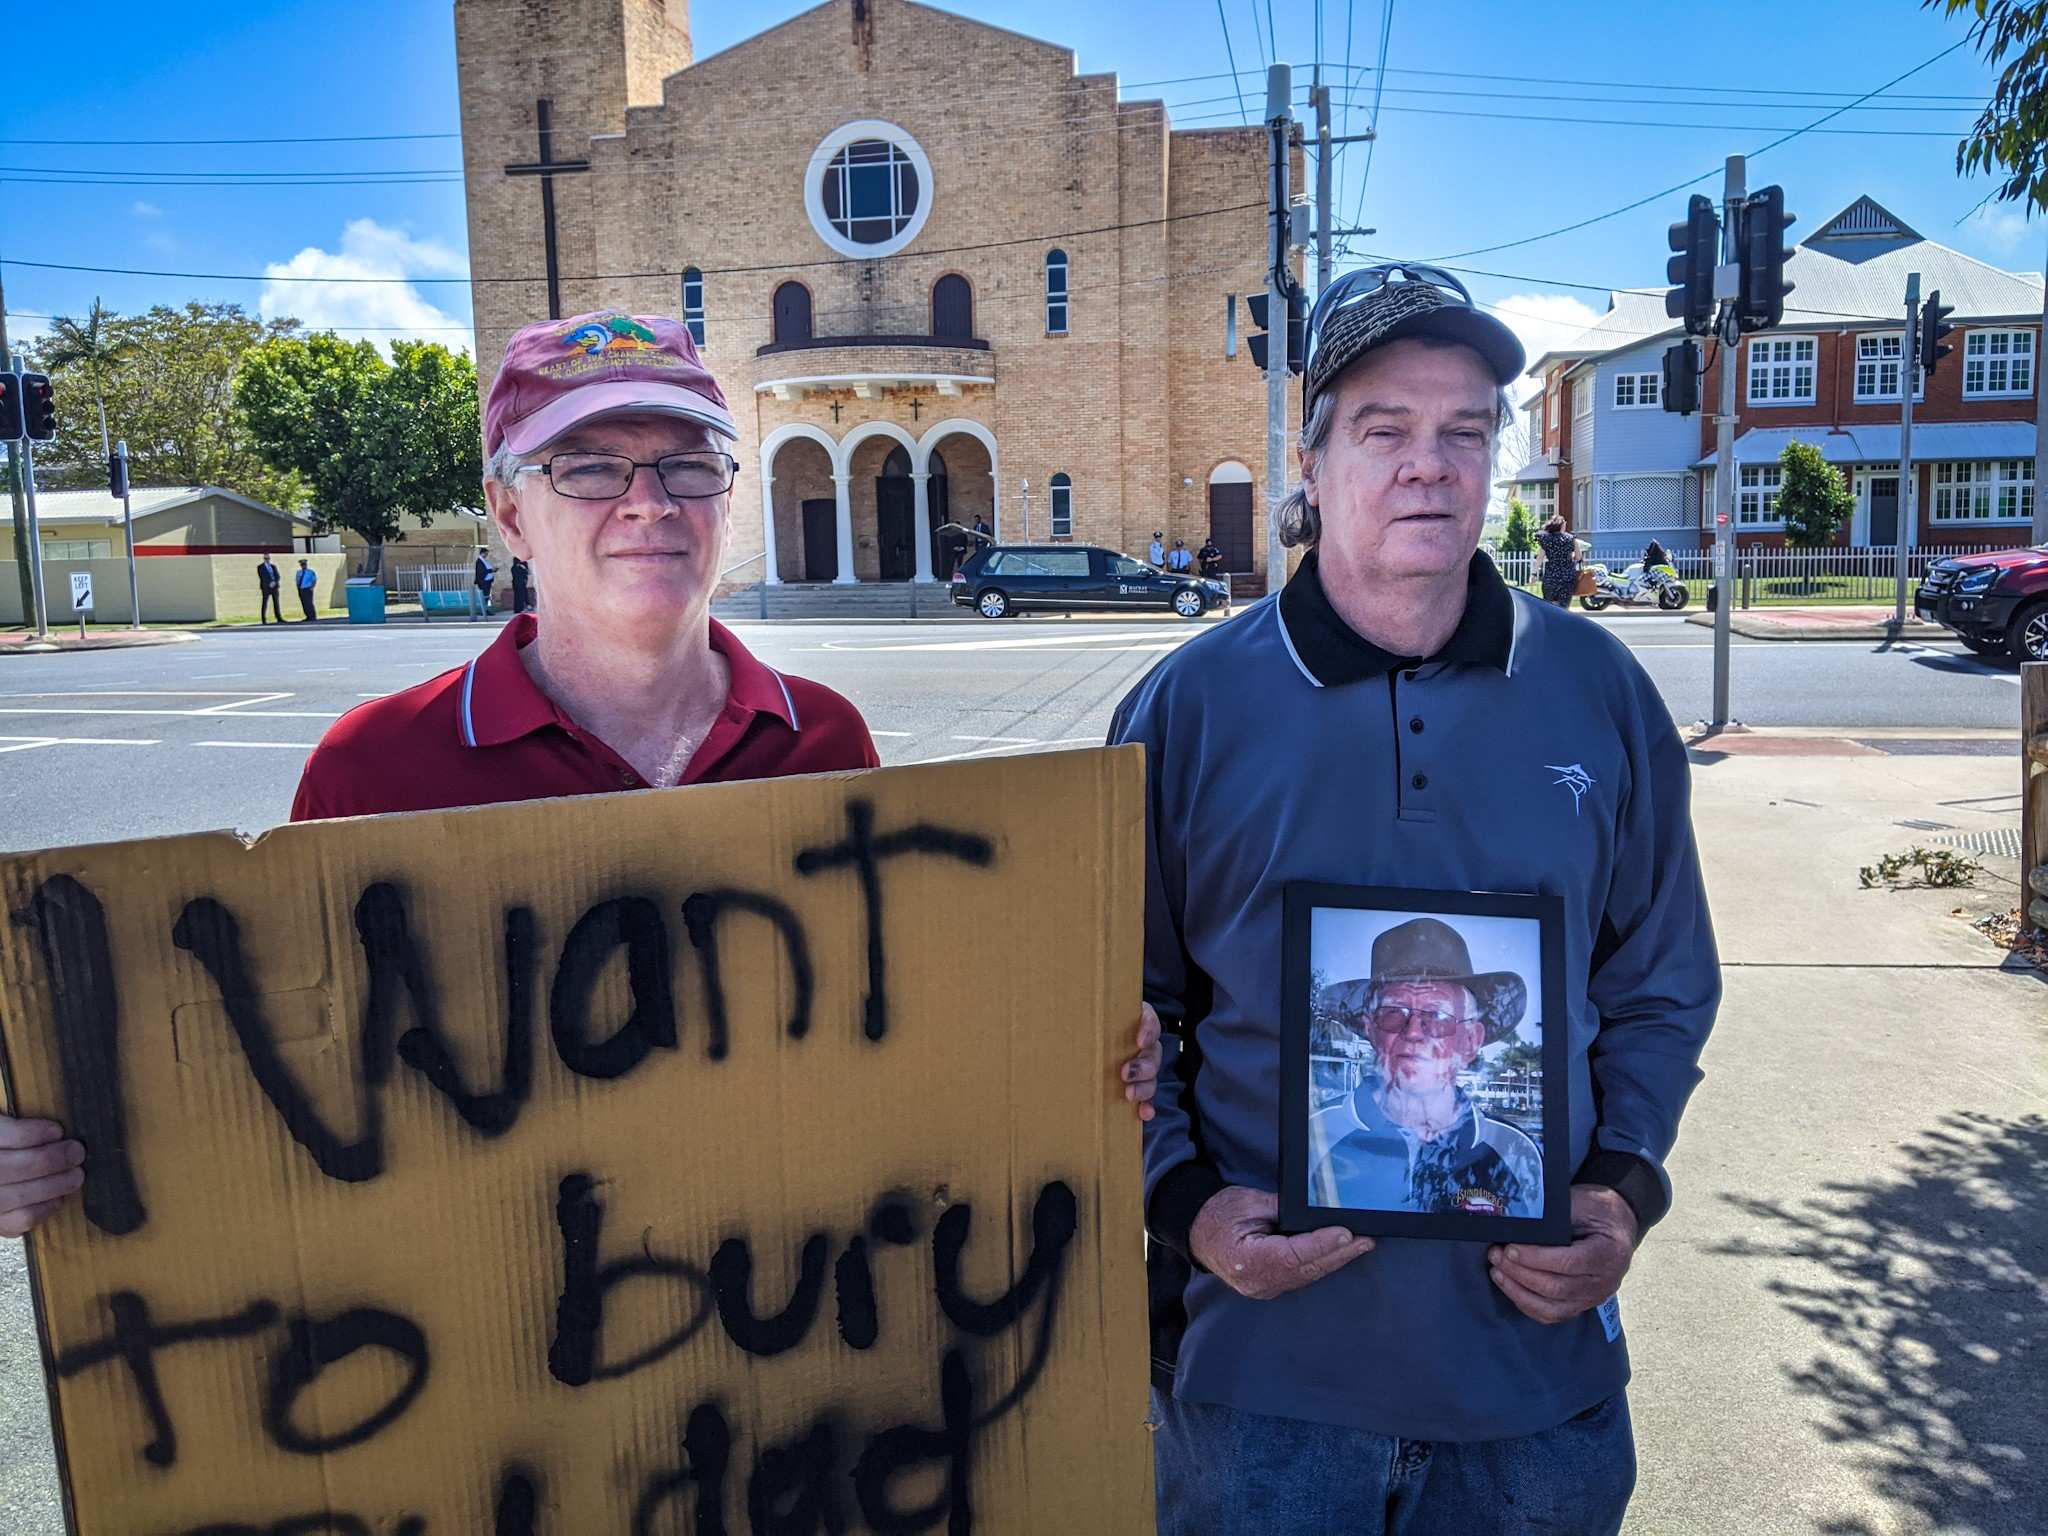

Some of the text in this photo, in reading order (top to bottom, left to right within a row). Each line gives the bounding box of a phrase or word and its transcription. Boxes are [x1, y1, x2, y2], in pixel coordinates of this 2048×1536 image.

[36, 798, 996, 1237] I Want
[57, 1171, 1079, 1467] to bury
